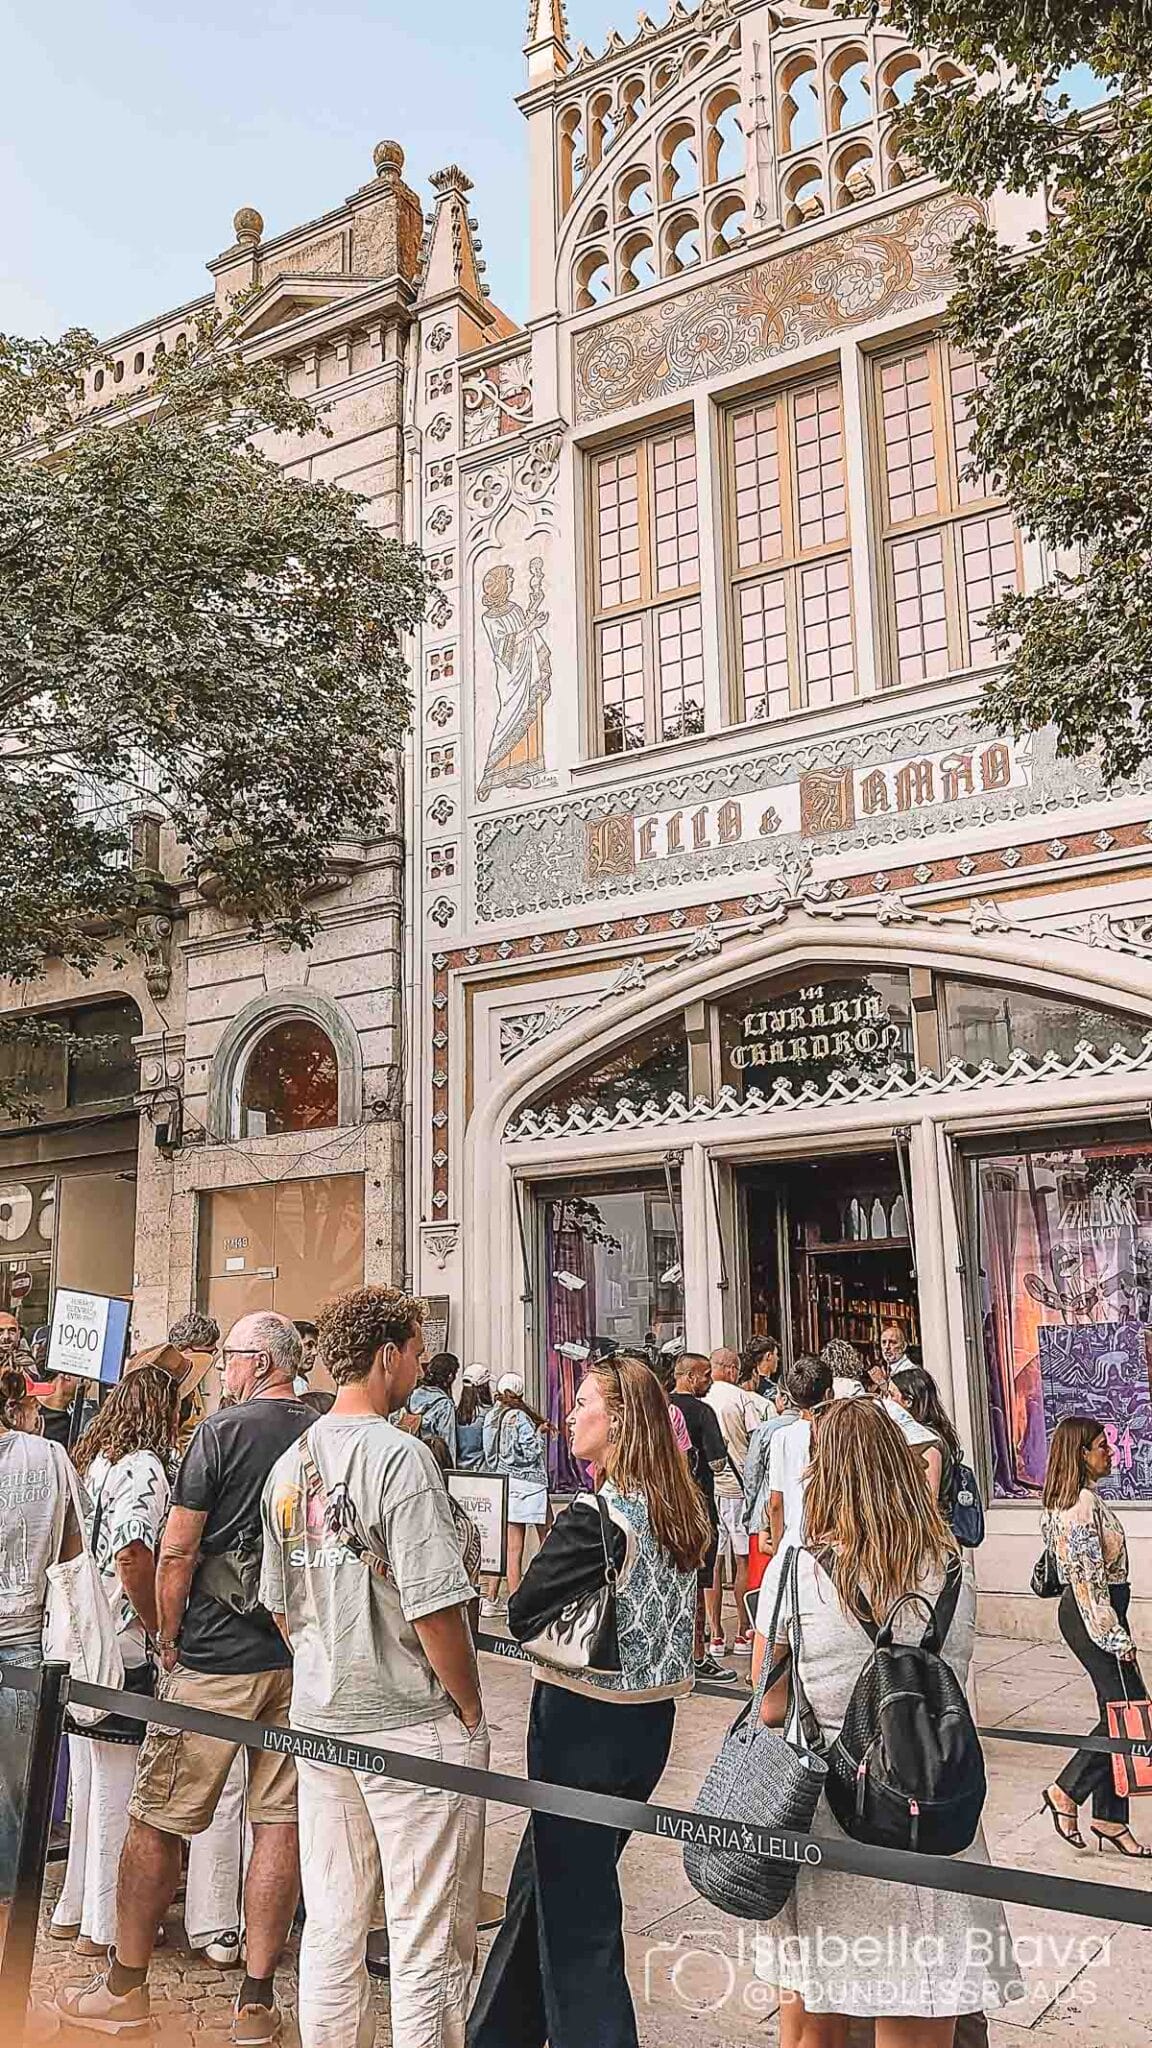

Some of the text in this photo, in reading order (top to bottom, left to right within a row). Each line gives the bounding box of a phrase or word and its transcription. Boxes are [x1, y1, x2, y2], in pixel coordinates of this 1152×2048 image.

[758, 806, 783, 836] &
[799, 985, 824, 1001] 144
[743, 994, 886, 1038] LIVRARIA
[729, 1024, 902, 1070] CHARDRON
[58, 1323, 99, 1352] 19:00
[263, 1730, 386, 1774] LIVRARIA LELLO
[656, 1814, 822, 1866] LIVRARIA LELLO
